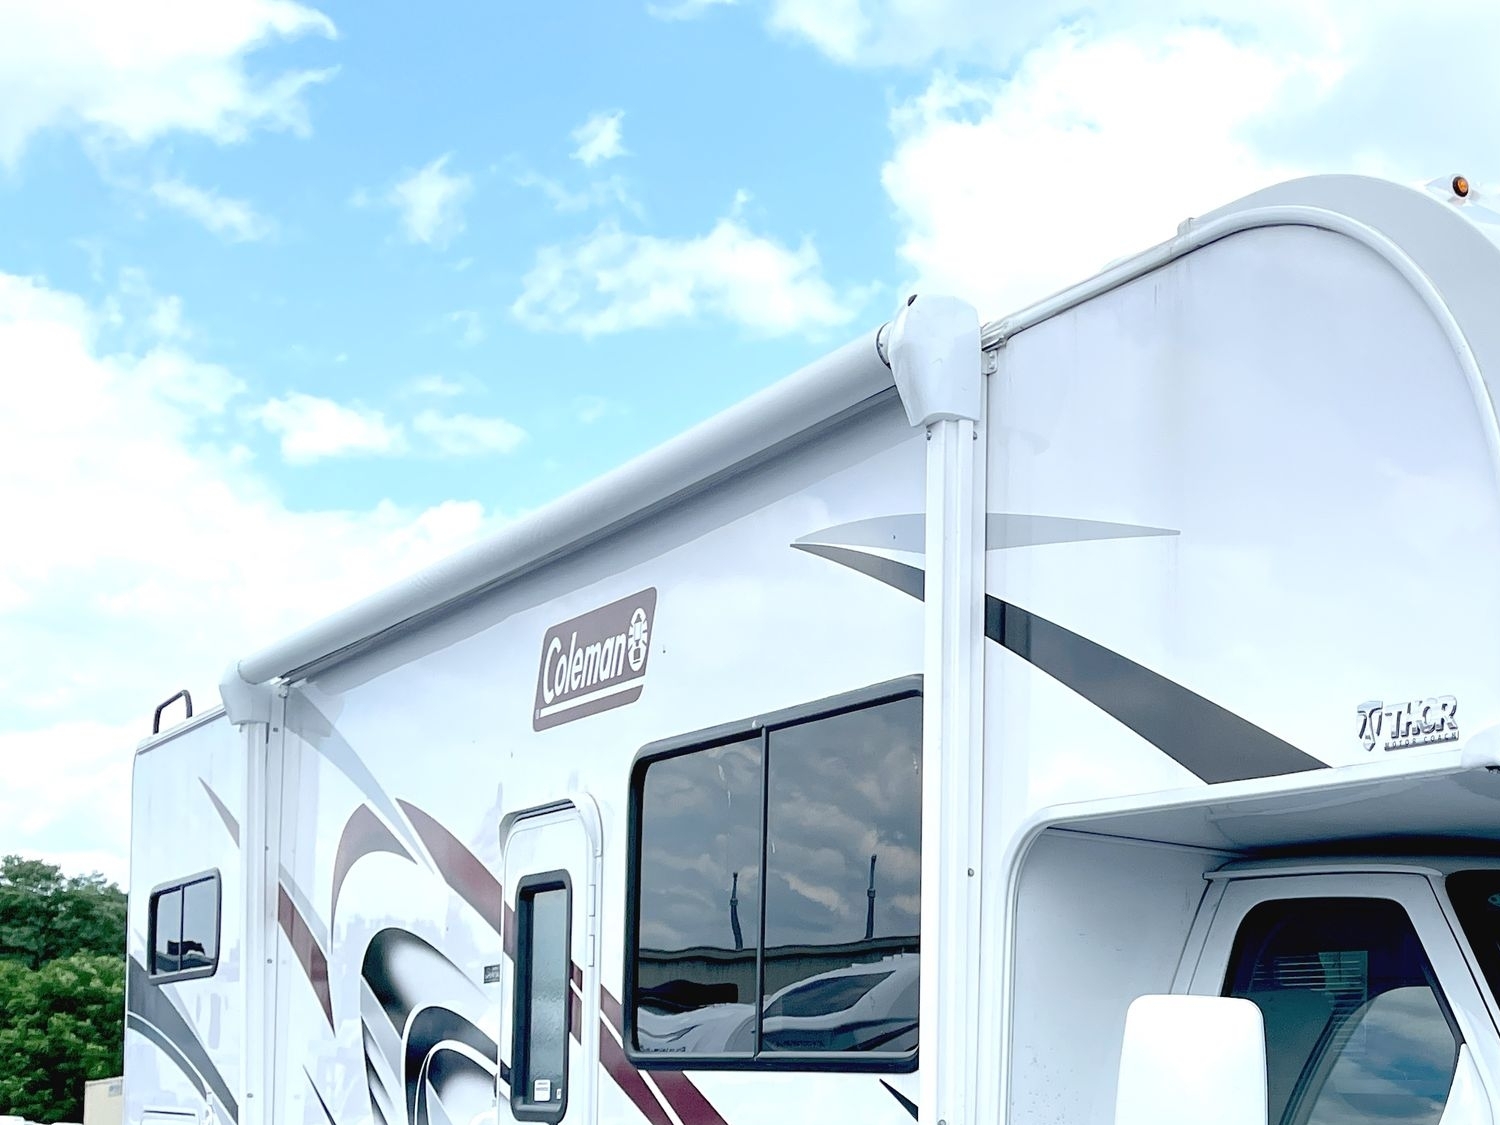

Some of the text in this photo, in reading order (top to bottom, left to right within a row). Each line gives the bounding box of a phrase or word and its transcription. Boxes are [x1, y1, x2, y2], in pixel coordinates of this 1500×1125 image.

[543, 631, 627, 704] Coleman
[1384, 695, 1458, 738] THOR
[1385, 738, 1417, 749] MOTOR
